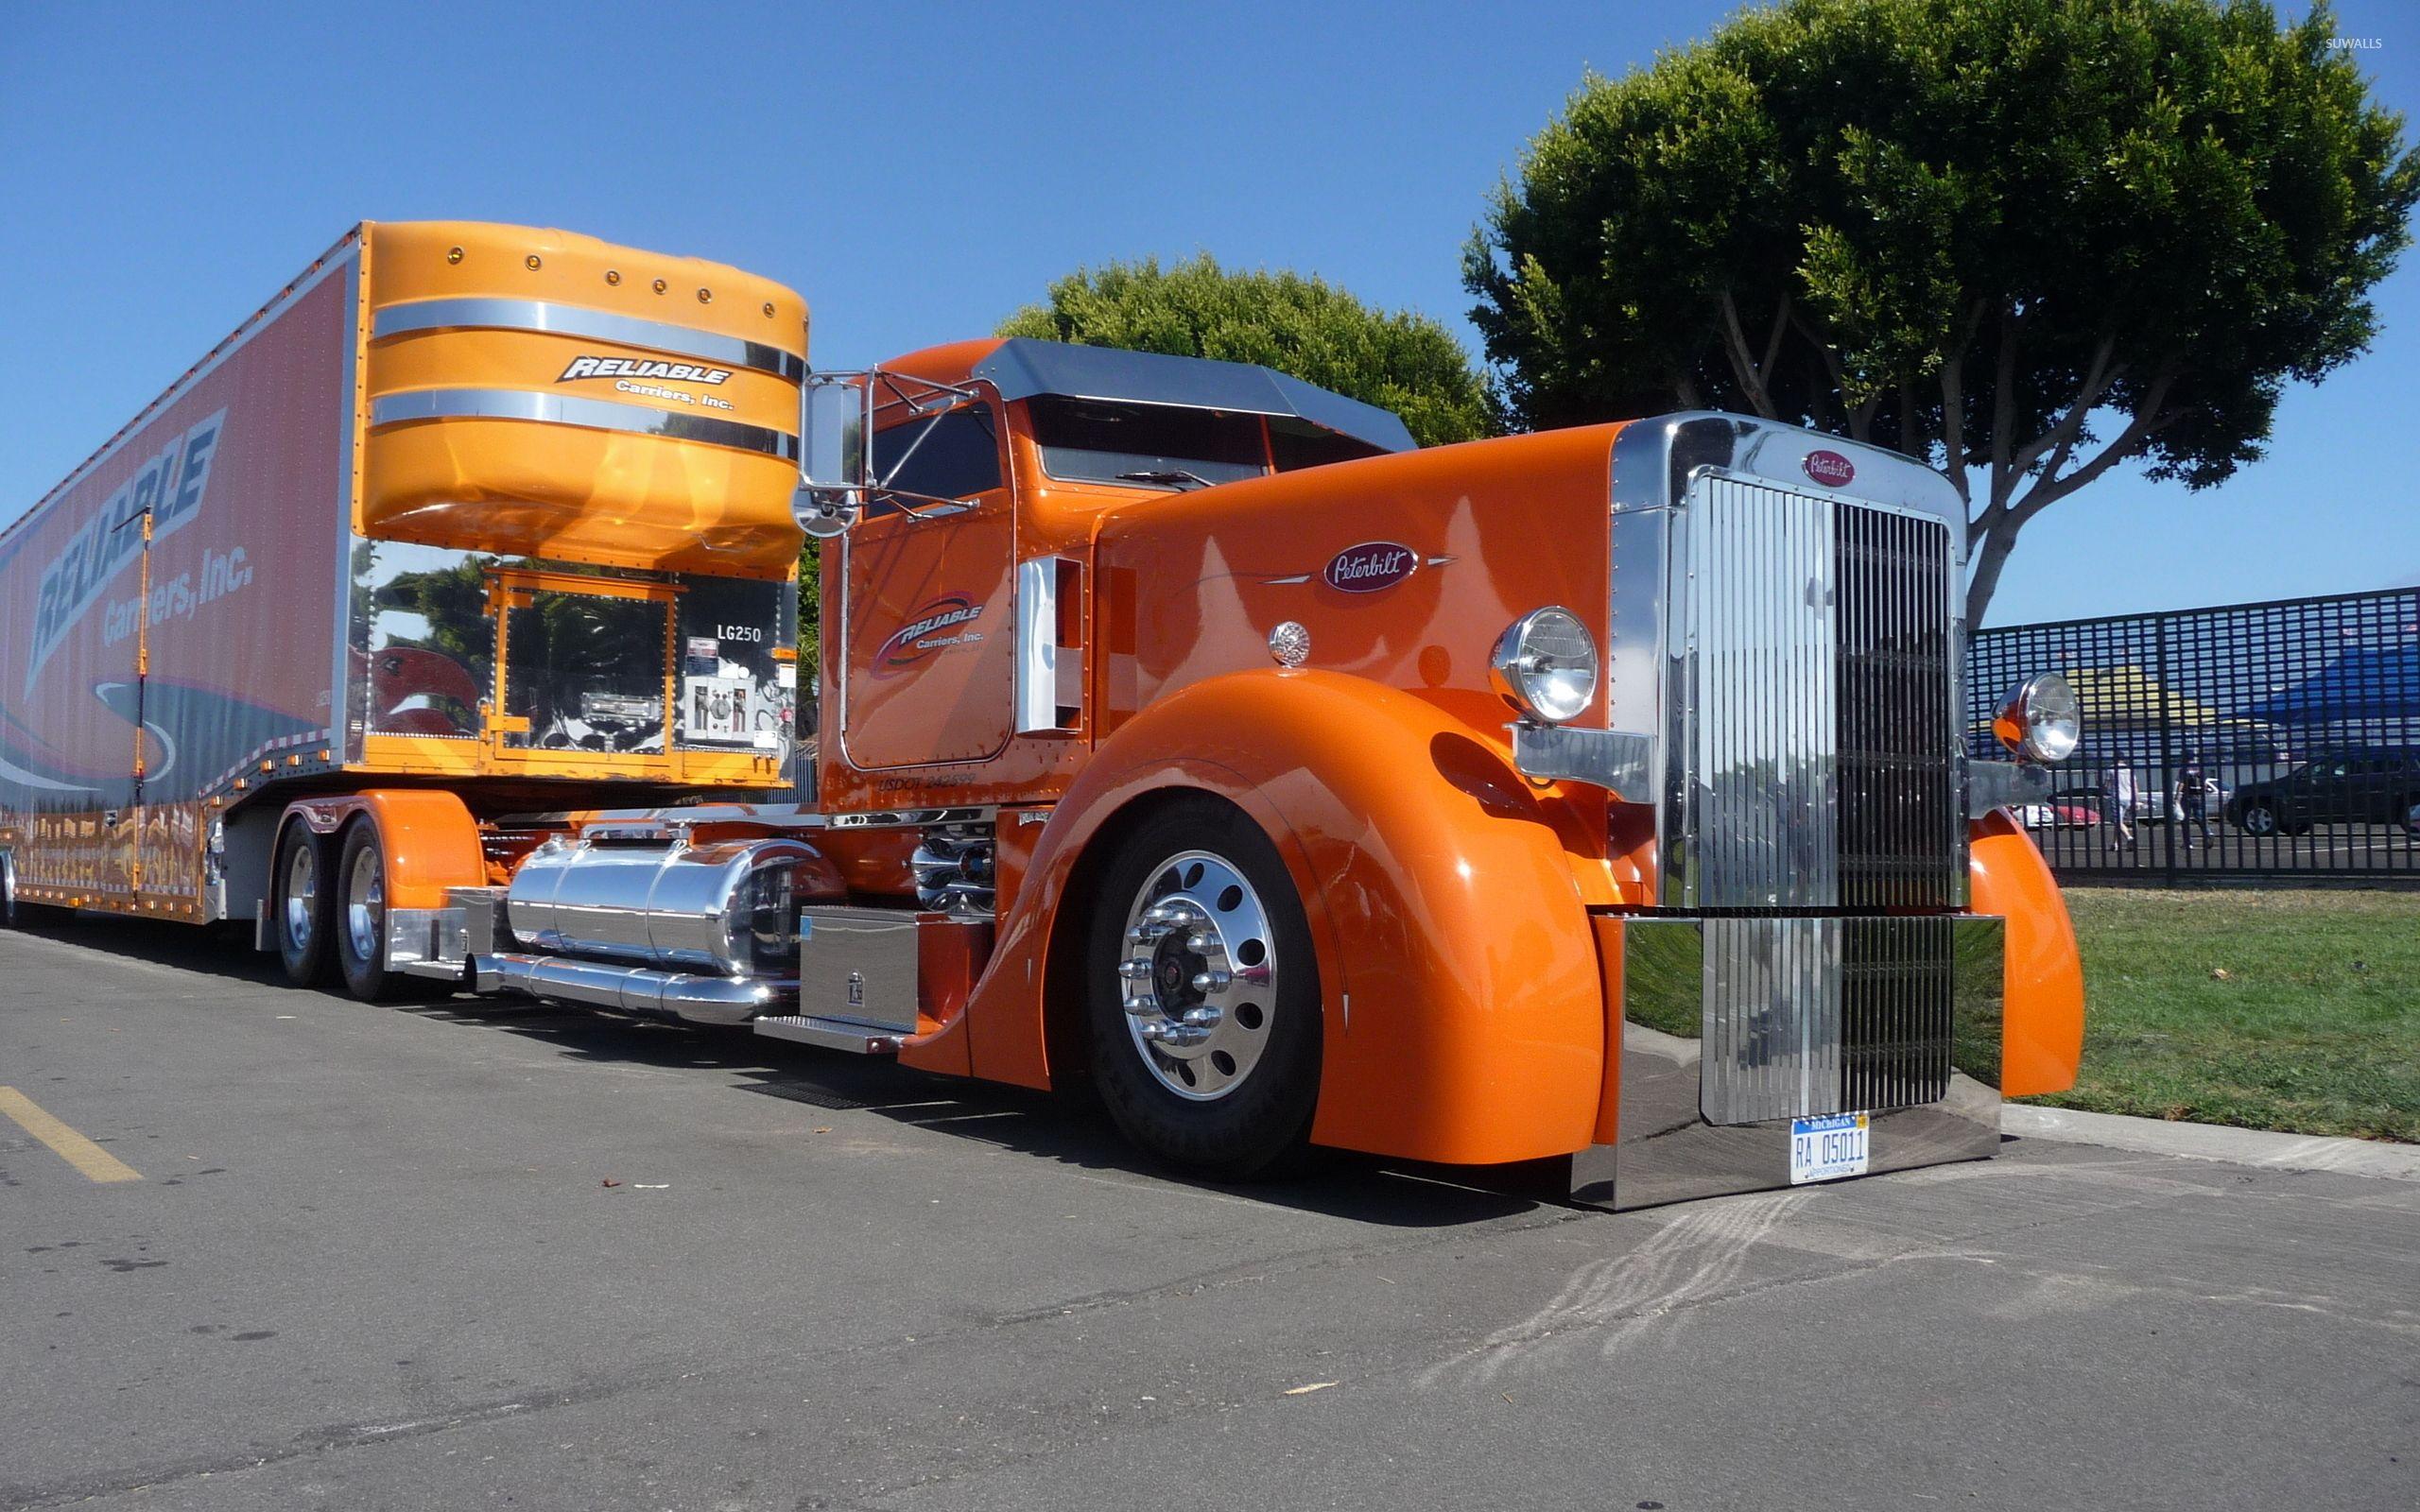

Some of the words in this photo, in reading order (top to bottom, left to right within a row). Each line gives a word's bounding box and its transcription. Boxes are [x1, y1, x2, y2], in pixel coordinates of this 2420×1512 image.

[562, 356, 731, 385] RELIABLE
[615, 380, 696, 404] Carriers,
[701, 394, 735, 410] Inc.
[1811, 454, 1851, 477] Peterbilt
[35, 426, 217, 660] RELIABLE
[199, 545, 253, 604] Inc.
[1334, 551, 1408, 584] Peterbilt
[717, 625, 762, 643] LG250
[900, 606, 983, 645] RELIABLE
[916, 636, 960, 649] Carriers,
[963, 633, 984, 643] Inc.
[878, 777, 923, 792] USDOT
[1810, 1116, 1851, 1131] MICHIGAN
[1796, 1137, 1812, 1168] RA
[1823, 1130, 1864, 1164] 05011
